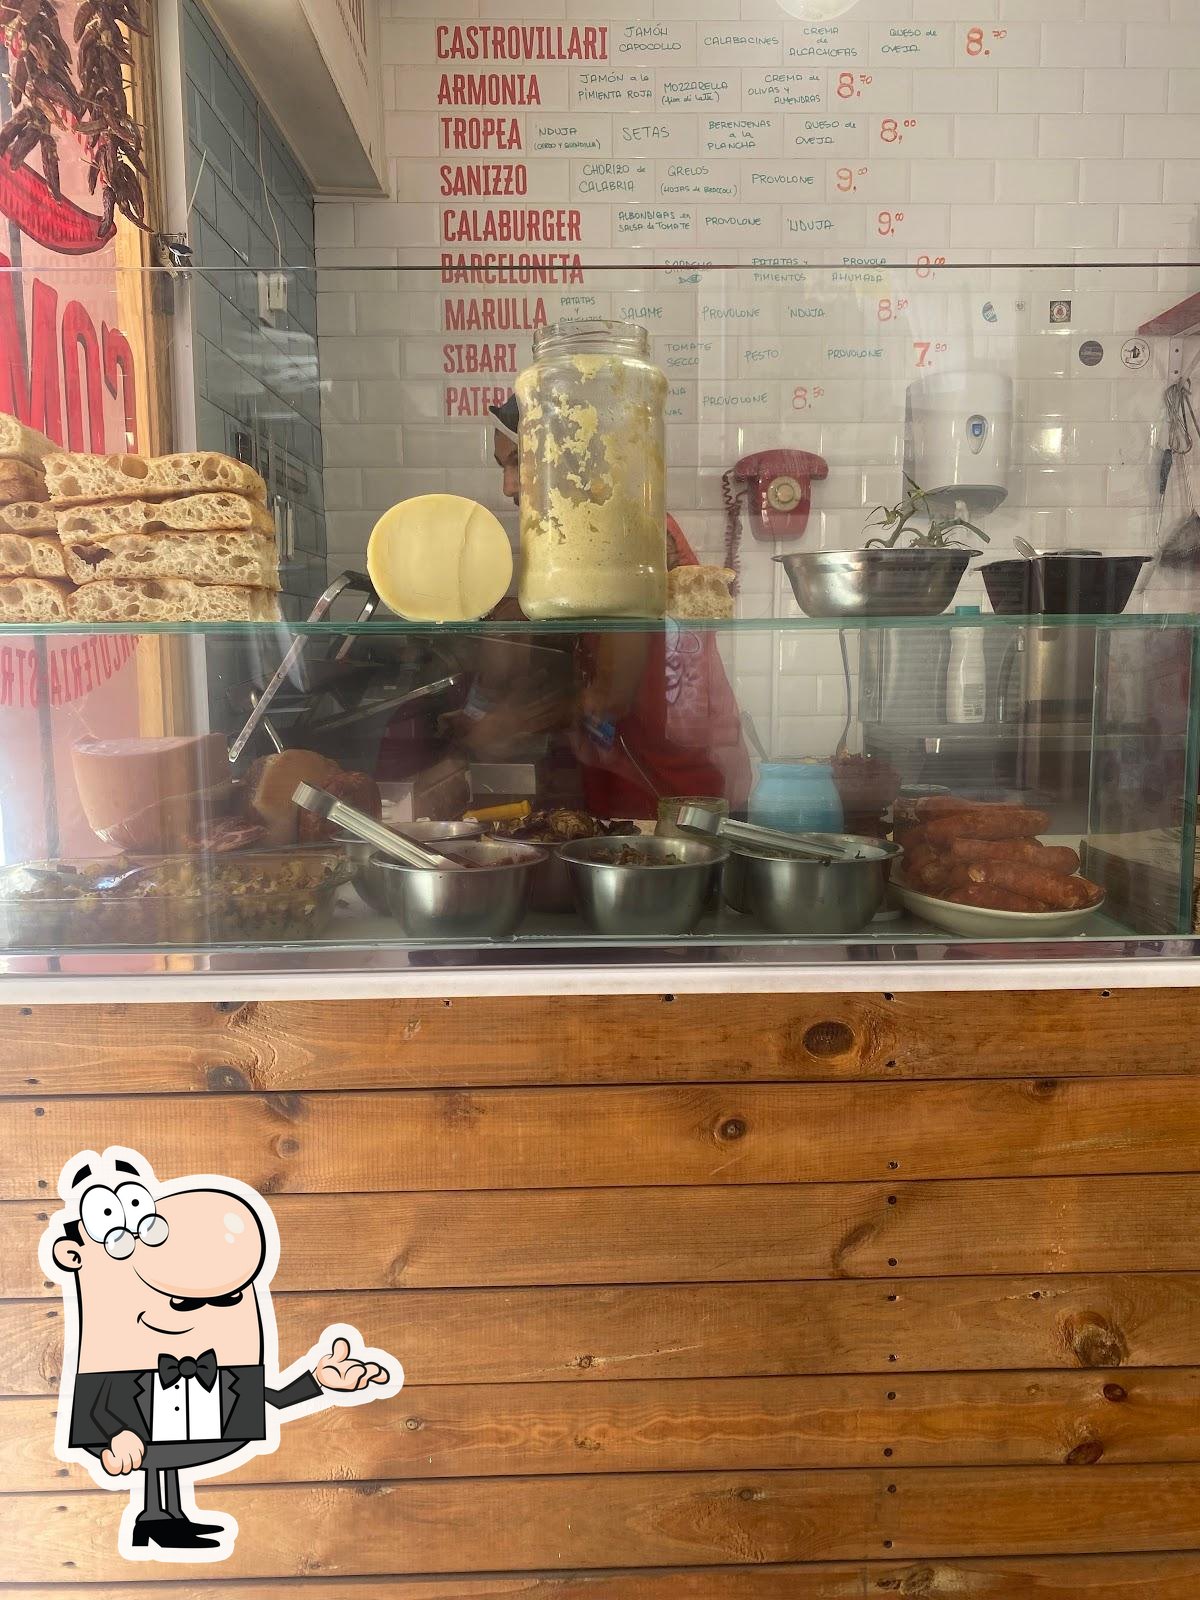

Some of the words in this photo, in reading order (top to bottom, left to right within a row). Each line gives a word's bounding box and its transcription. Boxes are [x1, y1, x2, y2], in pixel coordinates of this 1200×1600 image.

[624, 23, 668, 37] JAMÓN
[803, 27, 839, 36] CREMA
[889, 28, 922, 37] QUESO
[925, 29, 938, 37] de
[436, 26, 608, 60] CASTROVILLARI
[619, 42, 682, 52] CAPOCOLLO
[704, 36, 780, 46] CALABACINES
[789, 47, 858, 57] ALCACHOFAS
[881, 44, 921, 54] OVEJA
[579, 72, 624, 84] JAMÓN
[640, 73, 650, 82] la
[764, 74, 803, 83] CREMA
[438, 74, 542, 106] ARMONIA
[664, 81, 729, 93] MOZZARELLA
[748, 87, 780, 96] OLIVAS
[578, 88, 622, 101] PIMIENTA
[627, 89, 653, 99] ROJA
[708, 120, 772, 130] BERENJENAS
[804, 120, 840, 130] QUESO
[844, 121, 857, 129] de
[441, 117, 523, 150] TROPEA
[622, 126, 670, 141] SETAS
[741, 130, 755, 139] la
[707, 141, 757, 150] PLANCHA
[795, 136, 835, 145] OVEJA
[582, 163, 630, 176] CHORIZO
[667, 165, 710, 177] GRELOS
[440, 164, 528, 196] SANIZZO
[751, 173, 815, 185] PROVOLONE
[578, 180, 634, 193] CALABRIA
[443, 209, 582, 242] CALABURGER
[618, 223, 644, 233] SALSA
[656, 221, 691, 231] TOMATE
[705, 216, 762, 227] PROVOLONE
[752, 257, 800, 266] PATATAS
[842, 256, 888, 266] PROVOLA
[440, 253, 585, 284] BARCELONETA
[753, 272, 808, 282] PIMIENTOS
[831, 272, 884, 283] AHUMADA
[560, 296, 597, 306] PATATAS
[445, 297, 548, 331] MARULLA
[620, 306, 664, 320] SALAME
[702, 305, 761, 321] PROVOLONE
[664, 342, 713, 353] TOMATE
[443, 344, 517, 374] SIBARI
[744, 350, 780, 362] PESTO
[827, 349, 884, 359] PROVOLONE
[702, 393, 769, 408] PROVOLONE
